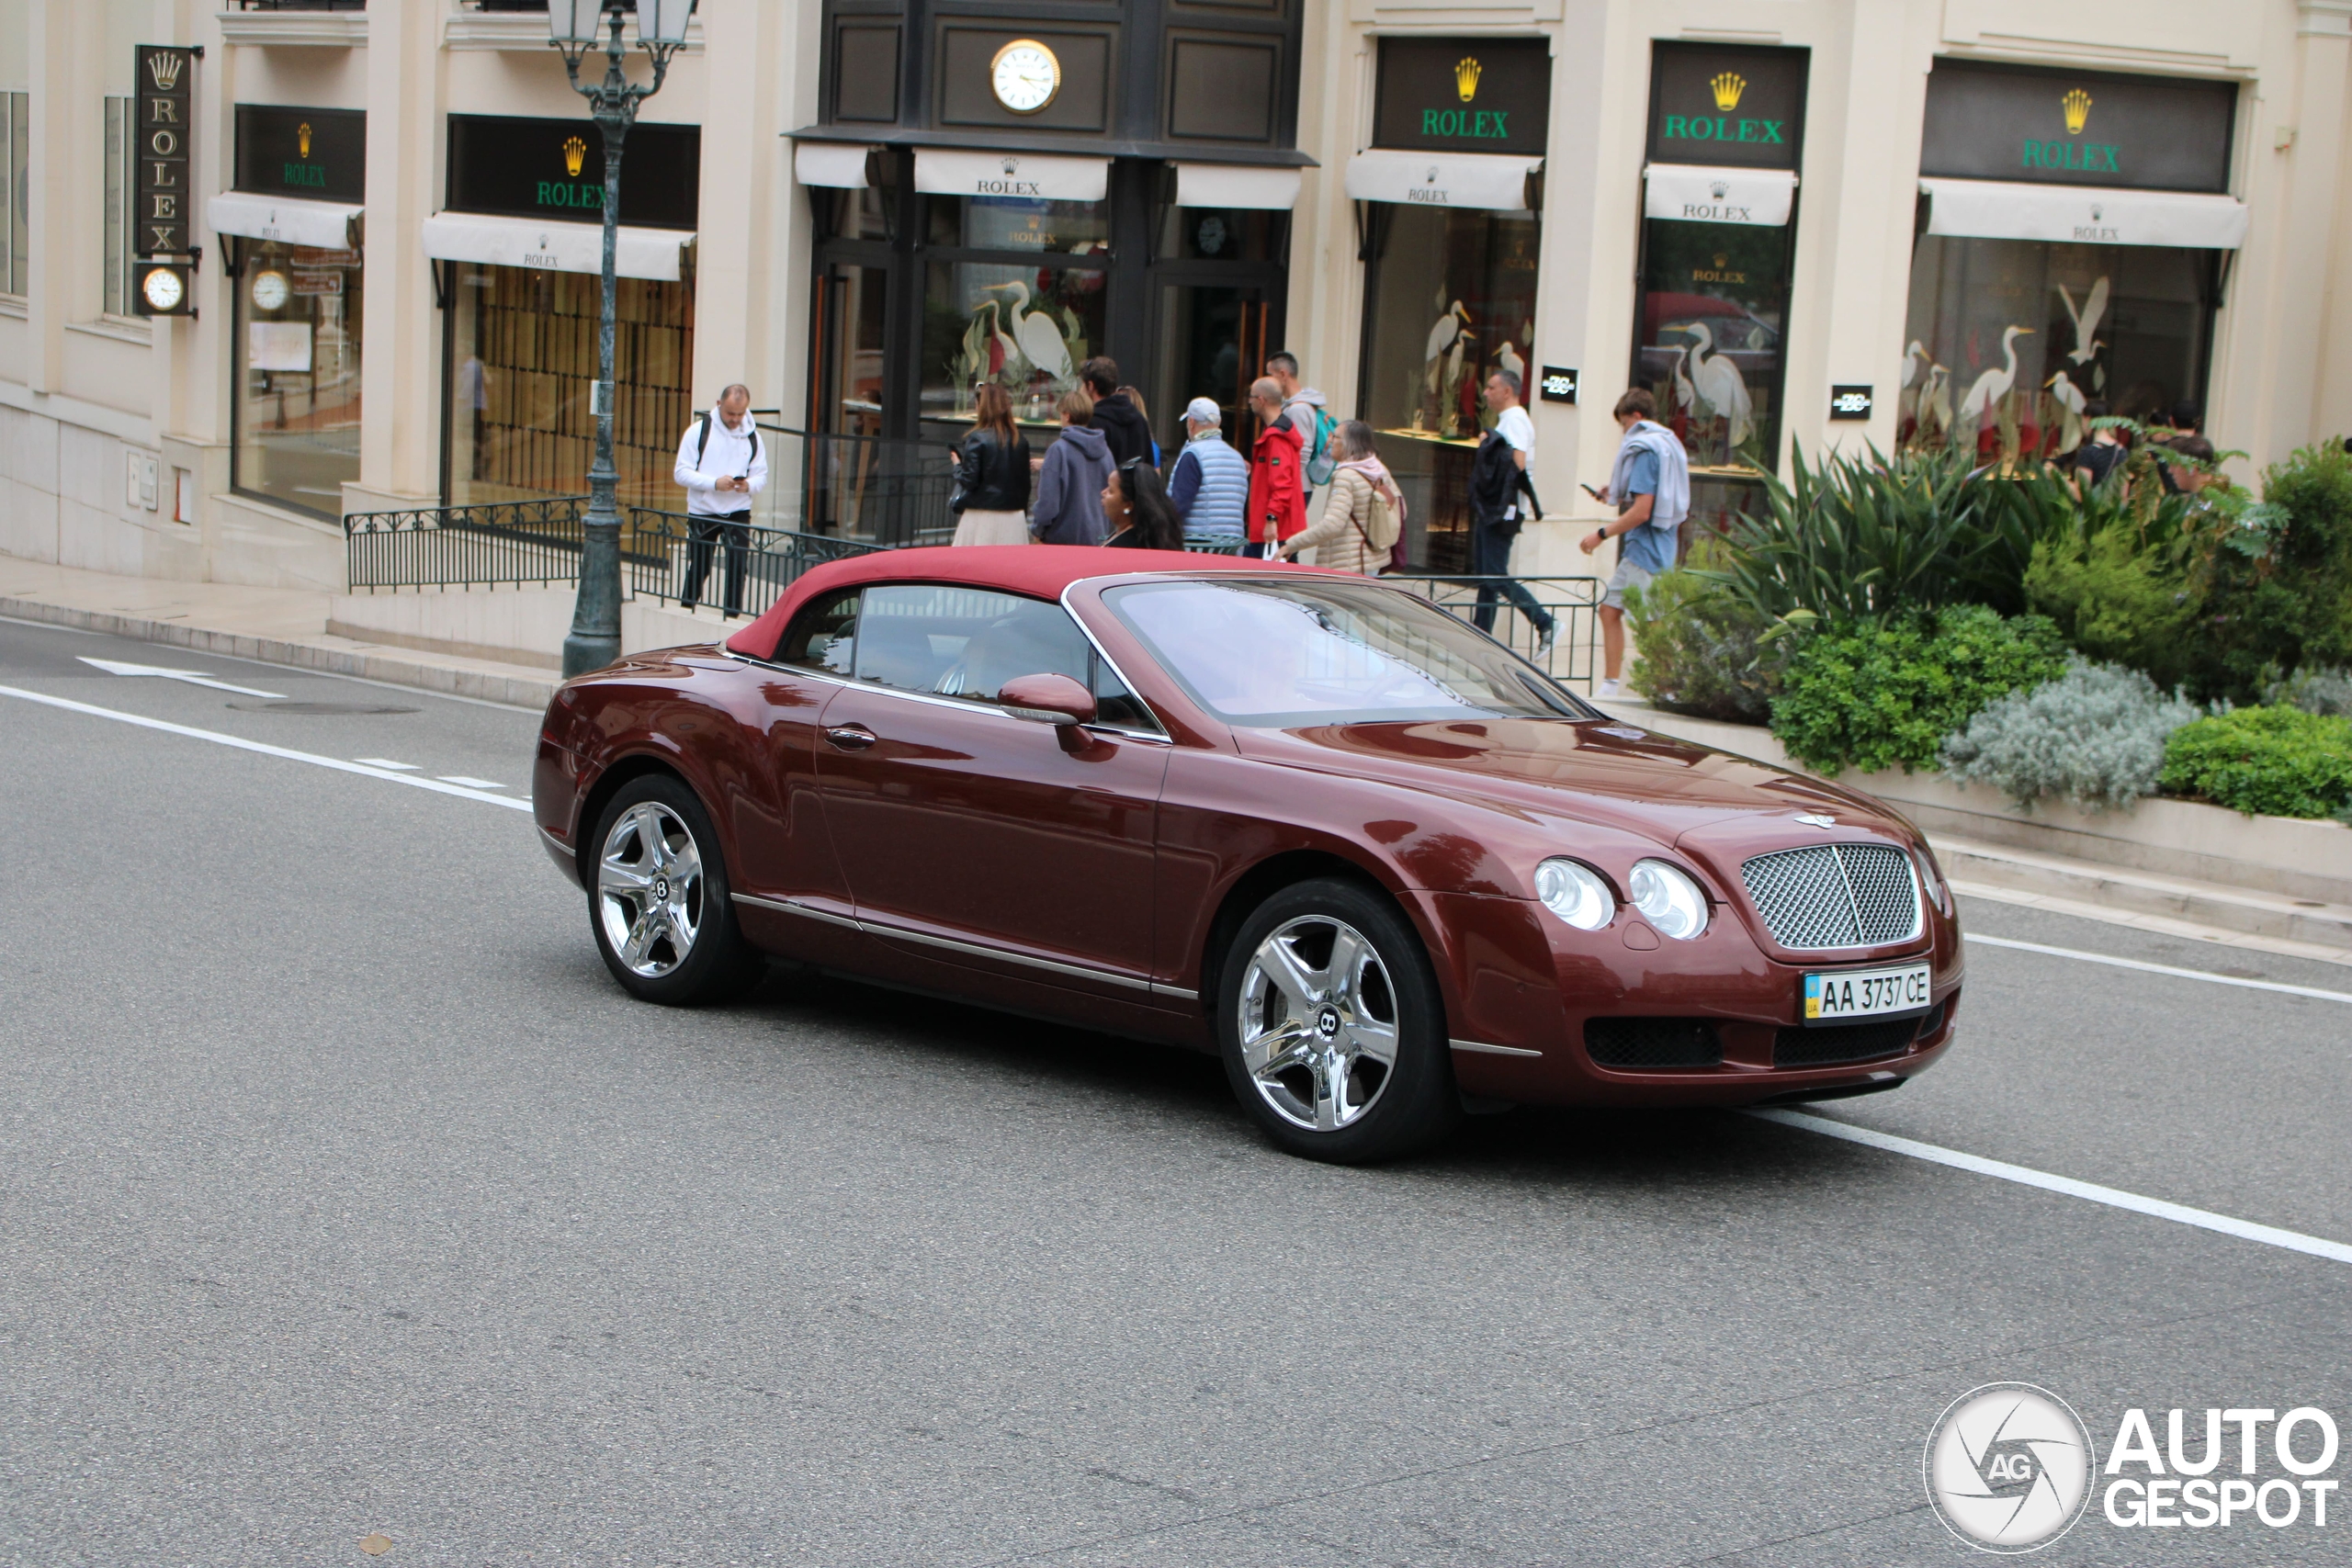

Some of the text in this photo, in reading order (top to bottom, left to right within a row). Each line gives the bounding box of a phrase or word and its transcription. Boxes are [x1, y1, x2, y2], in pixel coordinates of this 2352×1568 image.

[1421, 108, 1509, 138] ROLEX
[1664, 115, 1785, 144] ROLEX
[2021, 139, 2120, 173] ROLEX
[151, 98, 178, 251] ROLEX
[284, 164, 325, 186] ROLEX
[977, 180, 1041, 196] ROLEX
[1408, 188, 1449, 204] ROLEX
[1682, 204, 1752, 221] ROLEX
[1008, 231, 1057, 244] ROLEX
[2073, 226, 2120, 242] ROLEX
[524, 253, 558, 268] ROLEX
[1692, 269, 1746, 284] ROLEX
[1823, 972, 1928, 1012] AA 3737 CE
[1807, 1004, 1817, 1013] UA
